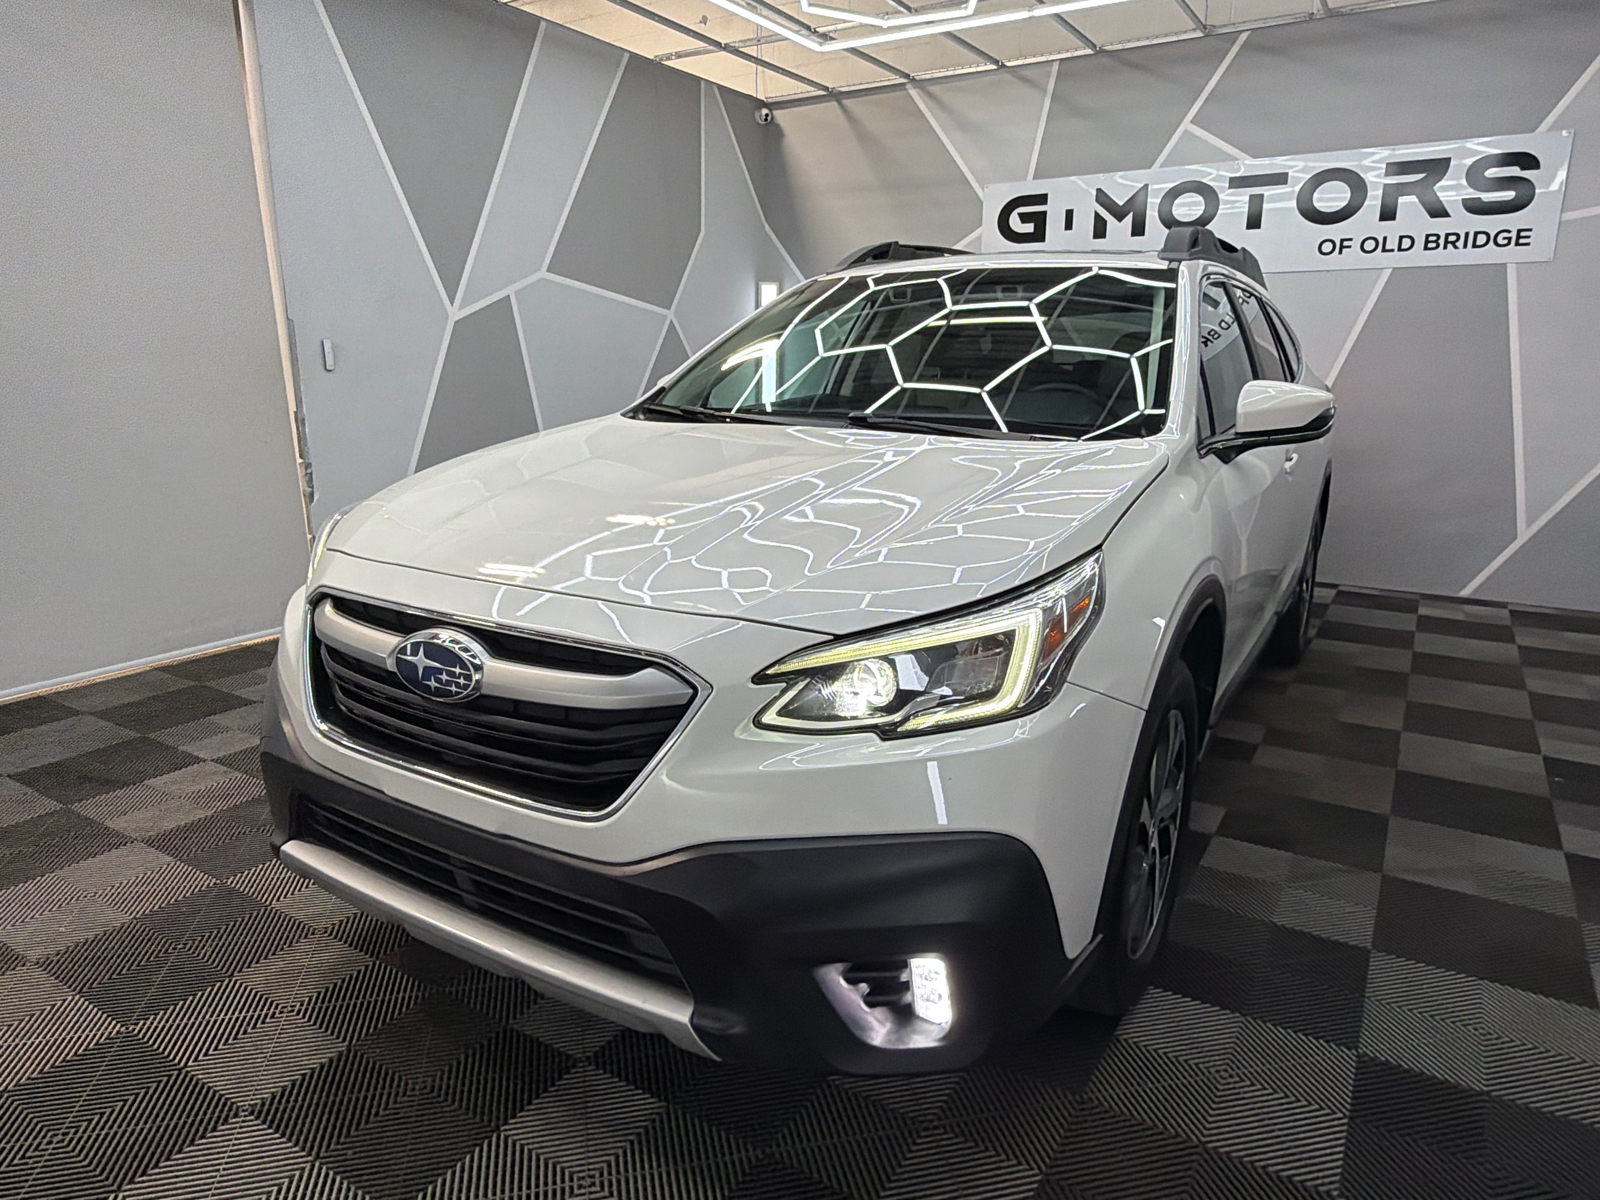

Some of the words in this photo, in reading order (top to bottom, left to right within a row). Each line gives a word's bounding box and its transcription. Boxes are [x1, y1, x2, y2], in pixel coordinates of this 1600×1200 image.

[1092, 151, 1541, 240] MOTORS
[1317, 237, 1353, 256] OF
[1359, 234, 1416, 254] OLD
[1422, 227, 1533, 251] BRIDGE
